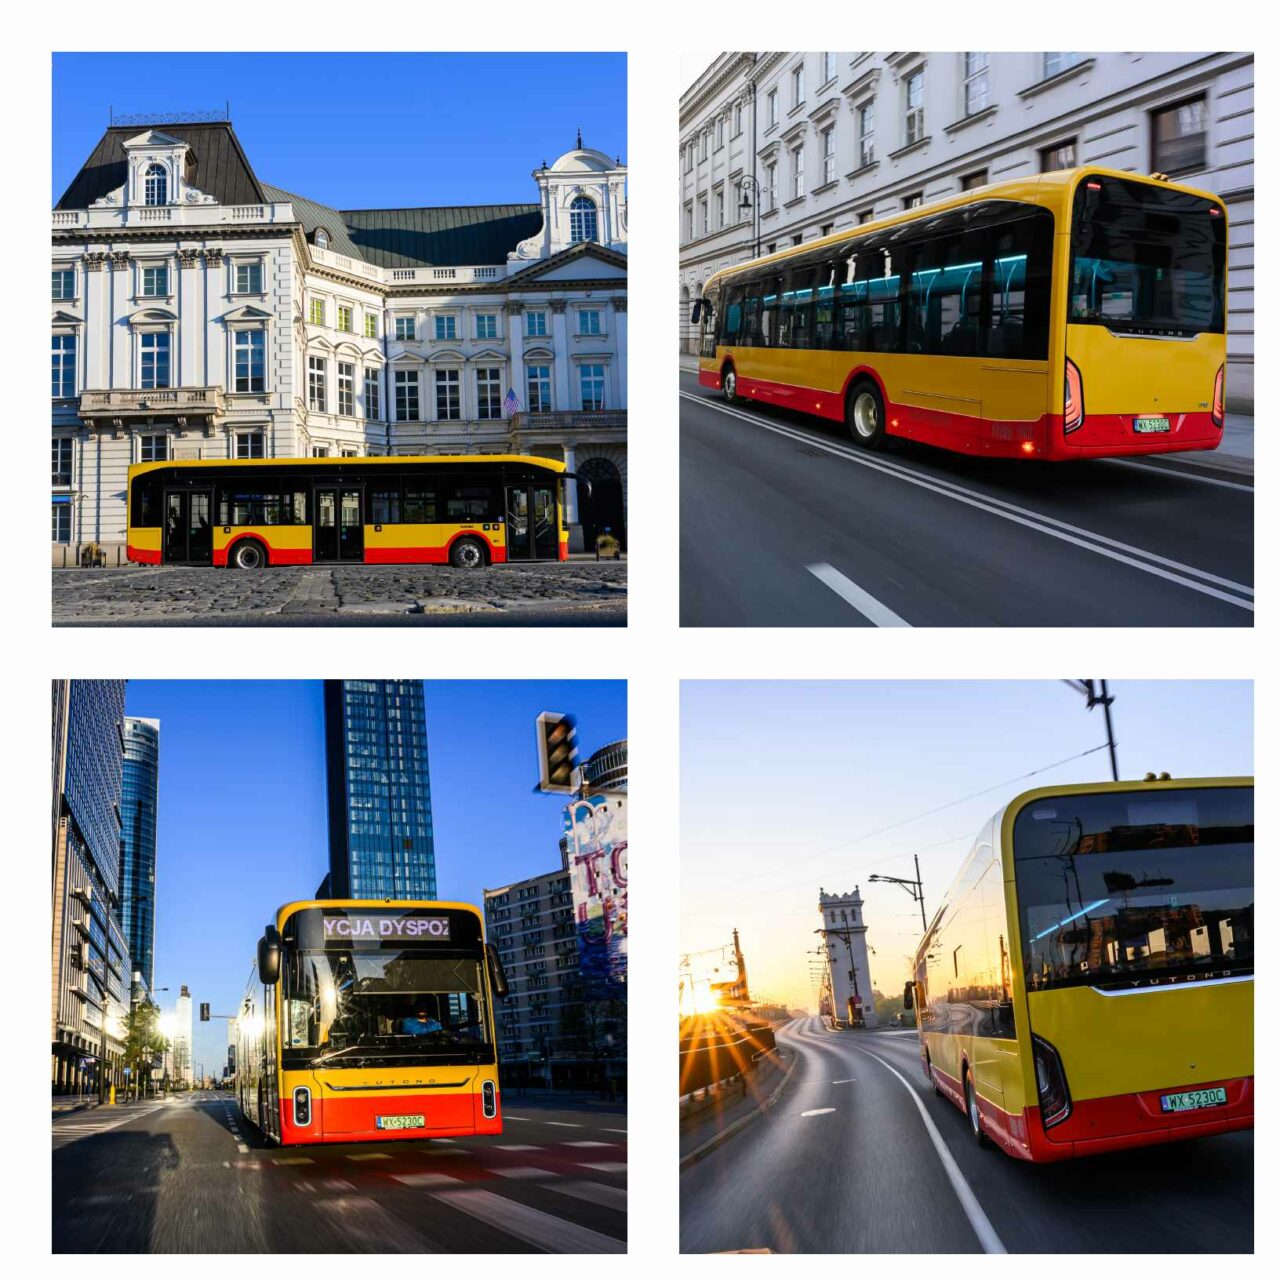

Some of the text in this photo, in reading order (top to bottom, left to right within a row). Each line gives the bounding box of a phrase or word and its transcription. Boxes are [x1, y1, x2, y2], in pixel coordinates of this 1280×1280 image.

[1131, 970, 1231, 986] YUTONG
[1169, 1096, 1184, 1108] WX
[1188, 1089, 1223, 1105] 5230C
[383, 1117, 423, 1126] WX 5230C
